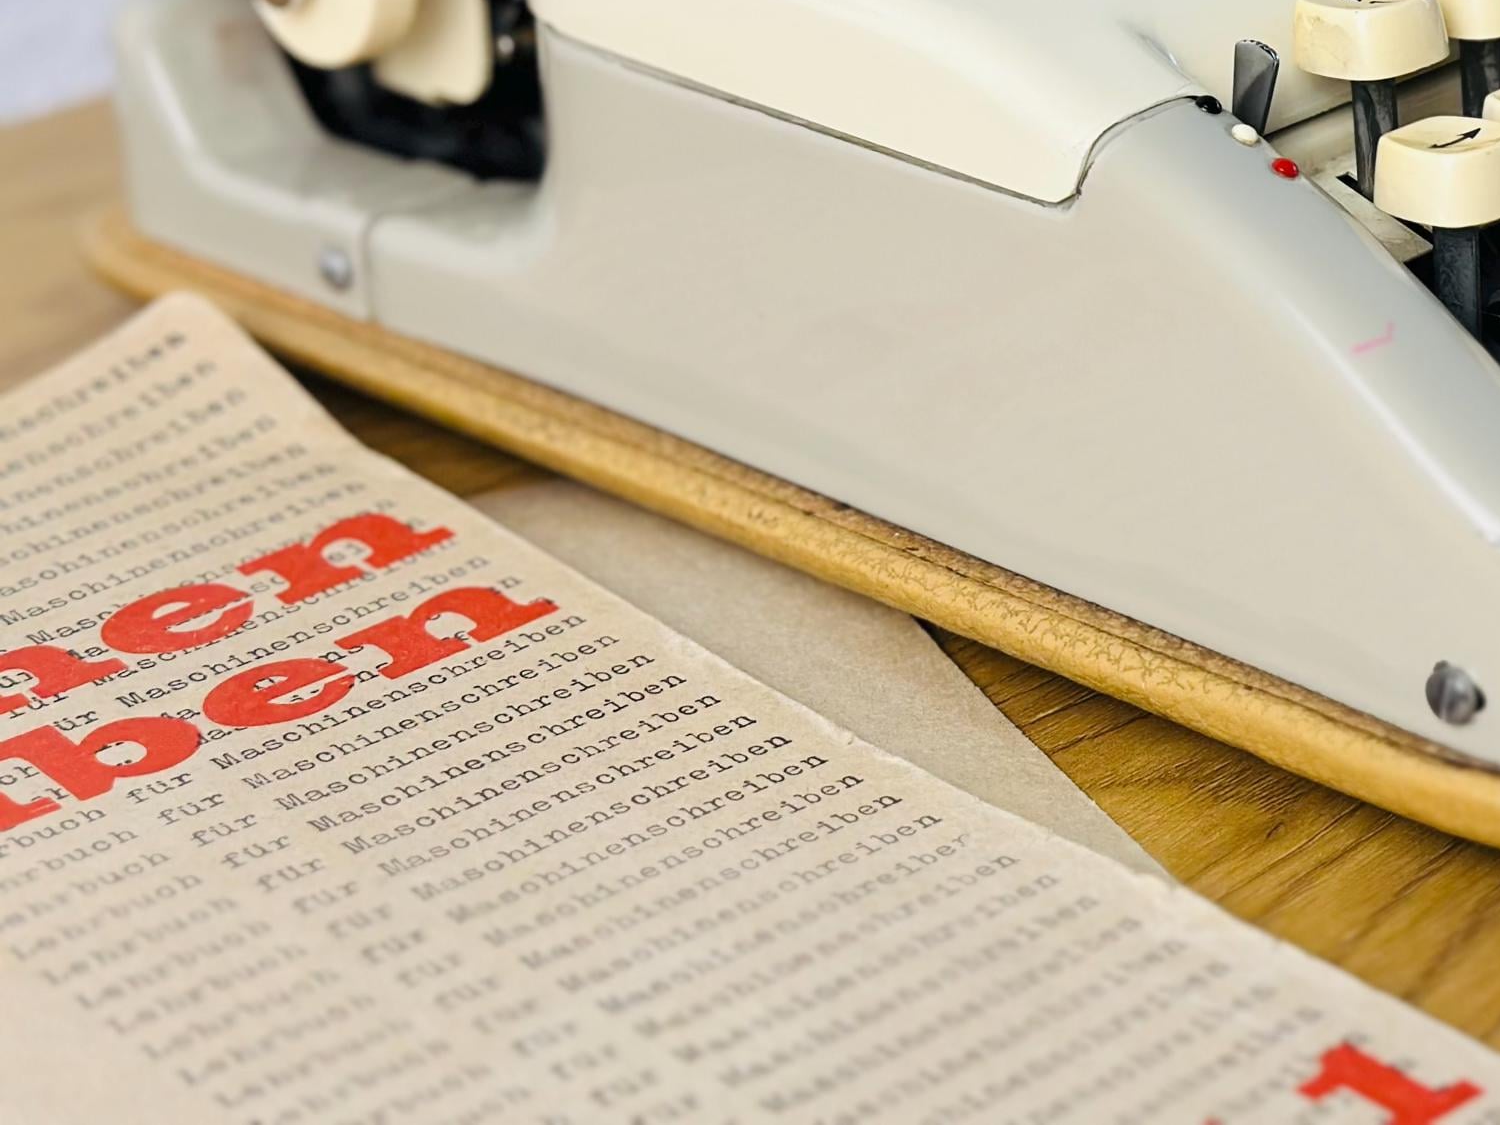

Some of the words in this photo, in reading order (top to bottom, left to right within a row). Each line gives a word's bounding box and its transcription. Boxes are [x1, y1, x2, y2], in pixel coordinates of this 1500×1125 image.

[0, 586, 560, 832] ben
[53, 710, 100, 732] ür
[116, 556, 492, 705] Maschinenschreiben
[127, 773, 194, 803] für
[210, 615, 588, 768] Maschinenschreiben
[158, 794, 226, 824] für
[242, 635, 621, 789] Maschinenschreiben
[191, 815, 259, 846] für
[274, 654, 655, 810] Maschinenschreiben
[224, 836, 292, 867] für
[307, 673, 689, 831] Maschinenschreiben
[257, 858, 326, 889] für
[341, 696, 723, 852] Maschinenschreiben
[291, 880, 360, 912] für
[375, 715, 758, 874] Maschinenschreiben
[410, 735, 793, 896] Maschinenschreiben
[445, 754, 829, 918] Maschinenschreiben
[481, 774, 866, 941] Maschinenschreiben
